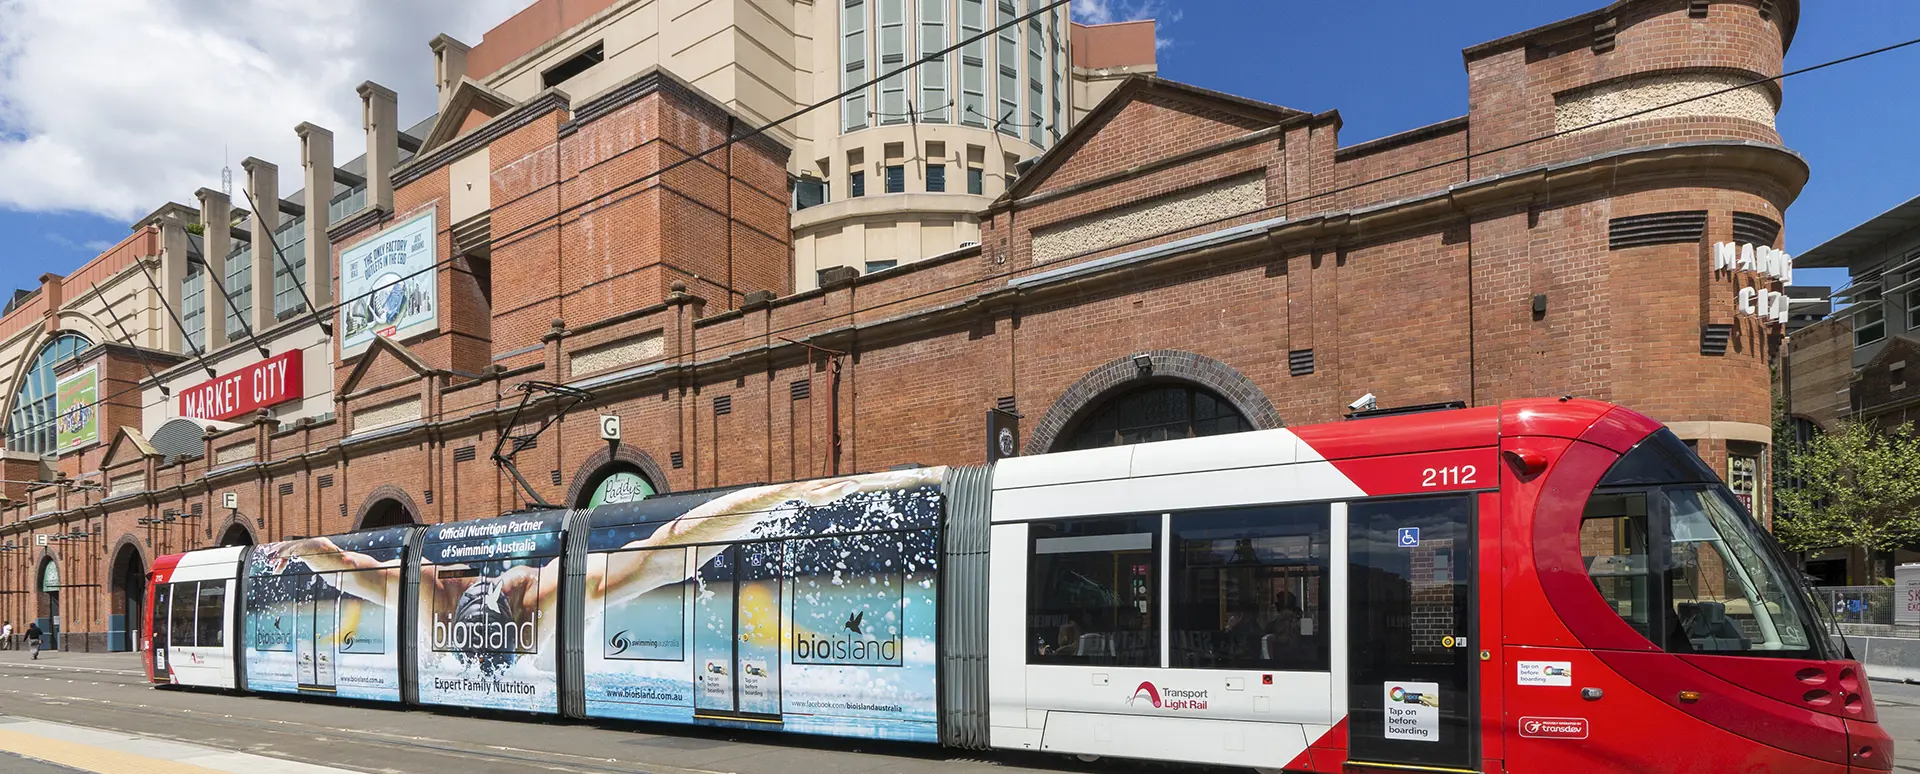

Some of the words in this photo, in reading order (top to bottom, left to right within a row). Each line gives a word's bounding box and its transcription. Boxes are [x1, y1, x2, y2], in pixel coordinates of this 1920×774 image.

[364, 253, 372, 268] THE
[373, 244, 385, 260] ONLY
[386, 240, 407, 253] FACTORY
[364, 257, 382, 280] OUTLETS
[383, 255, 388, 267] IN
[389, 253, 397, 265] THE
[397, 252, 407, 265] CBD
[185, 375, 242, 419] MARKET
[253, 358, 288, 403] CITY
[603, 417, 617, 437] G
[1421, 464, 1477, 487] 2112
[603, 477, 641, 503] Paddy's
[226, 494, 234, 506] F
[439, 525, 469, 540] Official
[468, 522, 508, 537] Nutrition
[508, 520, 544, 532] Partner
[38, 535, 45, 545] E
[441, 545, 452, 558] of
[450, 542, 495, 558] Swimming
[495, 539, 536, 554] Australia
[434, 611, 535, 650] bioisland
[797, 633, 896, 661] bioisland
[434, 677, 462, 691] Expert
[463, 678, 491, 695] Family
[493, 680, 536, 695] Nutrition
[606, 689, 683, 701] www.bioisland.com.au
[1162, 687, 1208, 699] Transport
[791, 700, 903, 712] www.facebook.com/bioislandaustralia
[1164, 700, 1187, 711] Light
[1189, 700, 1208, 710] Rail
[1388, 707, 1403, 716] Tap
[1388, 716, 1417, 725] before
[1542, 724, 1582, 733] transdev
[1388, 725, 1428, 737] boarding
